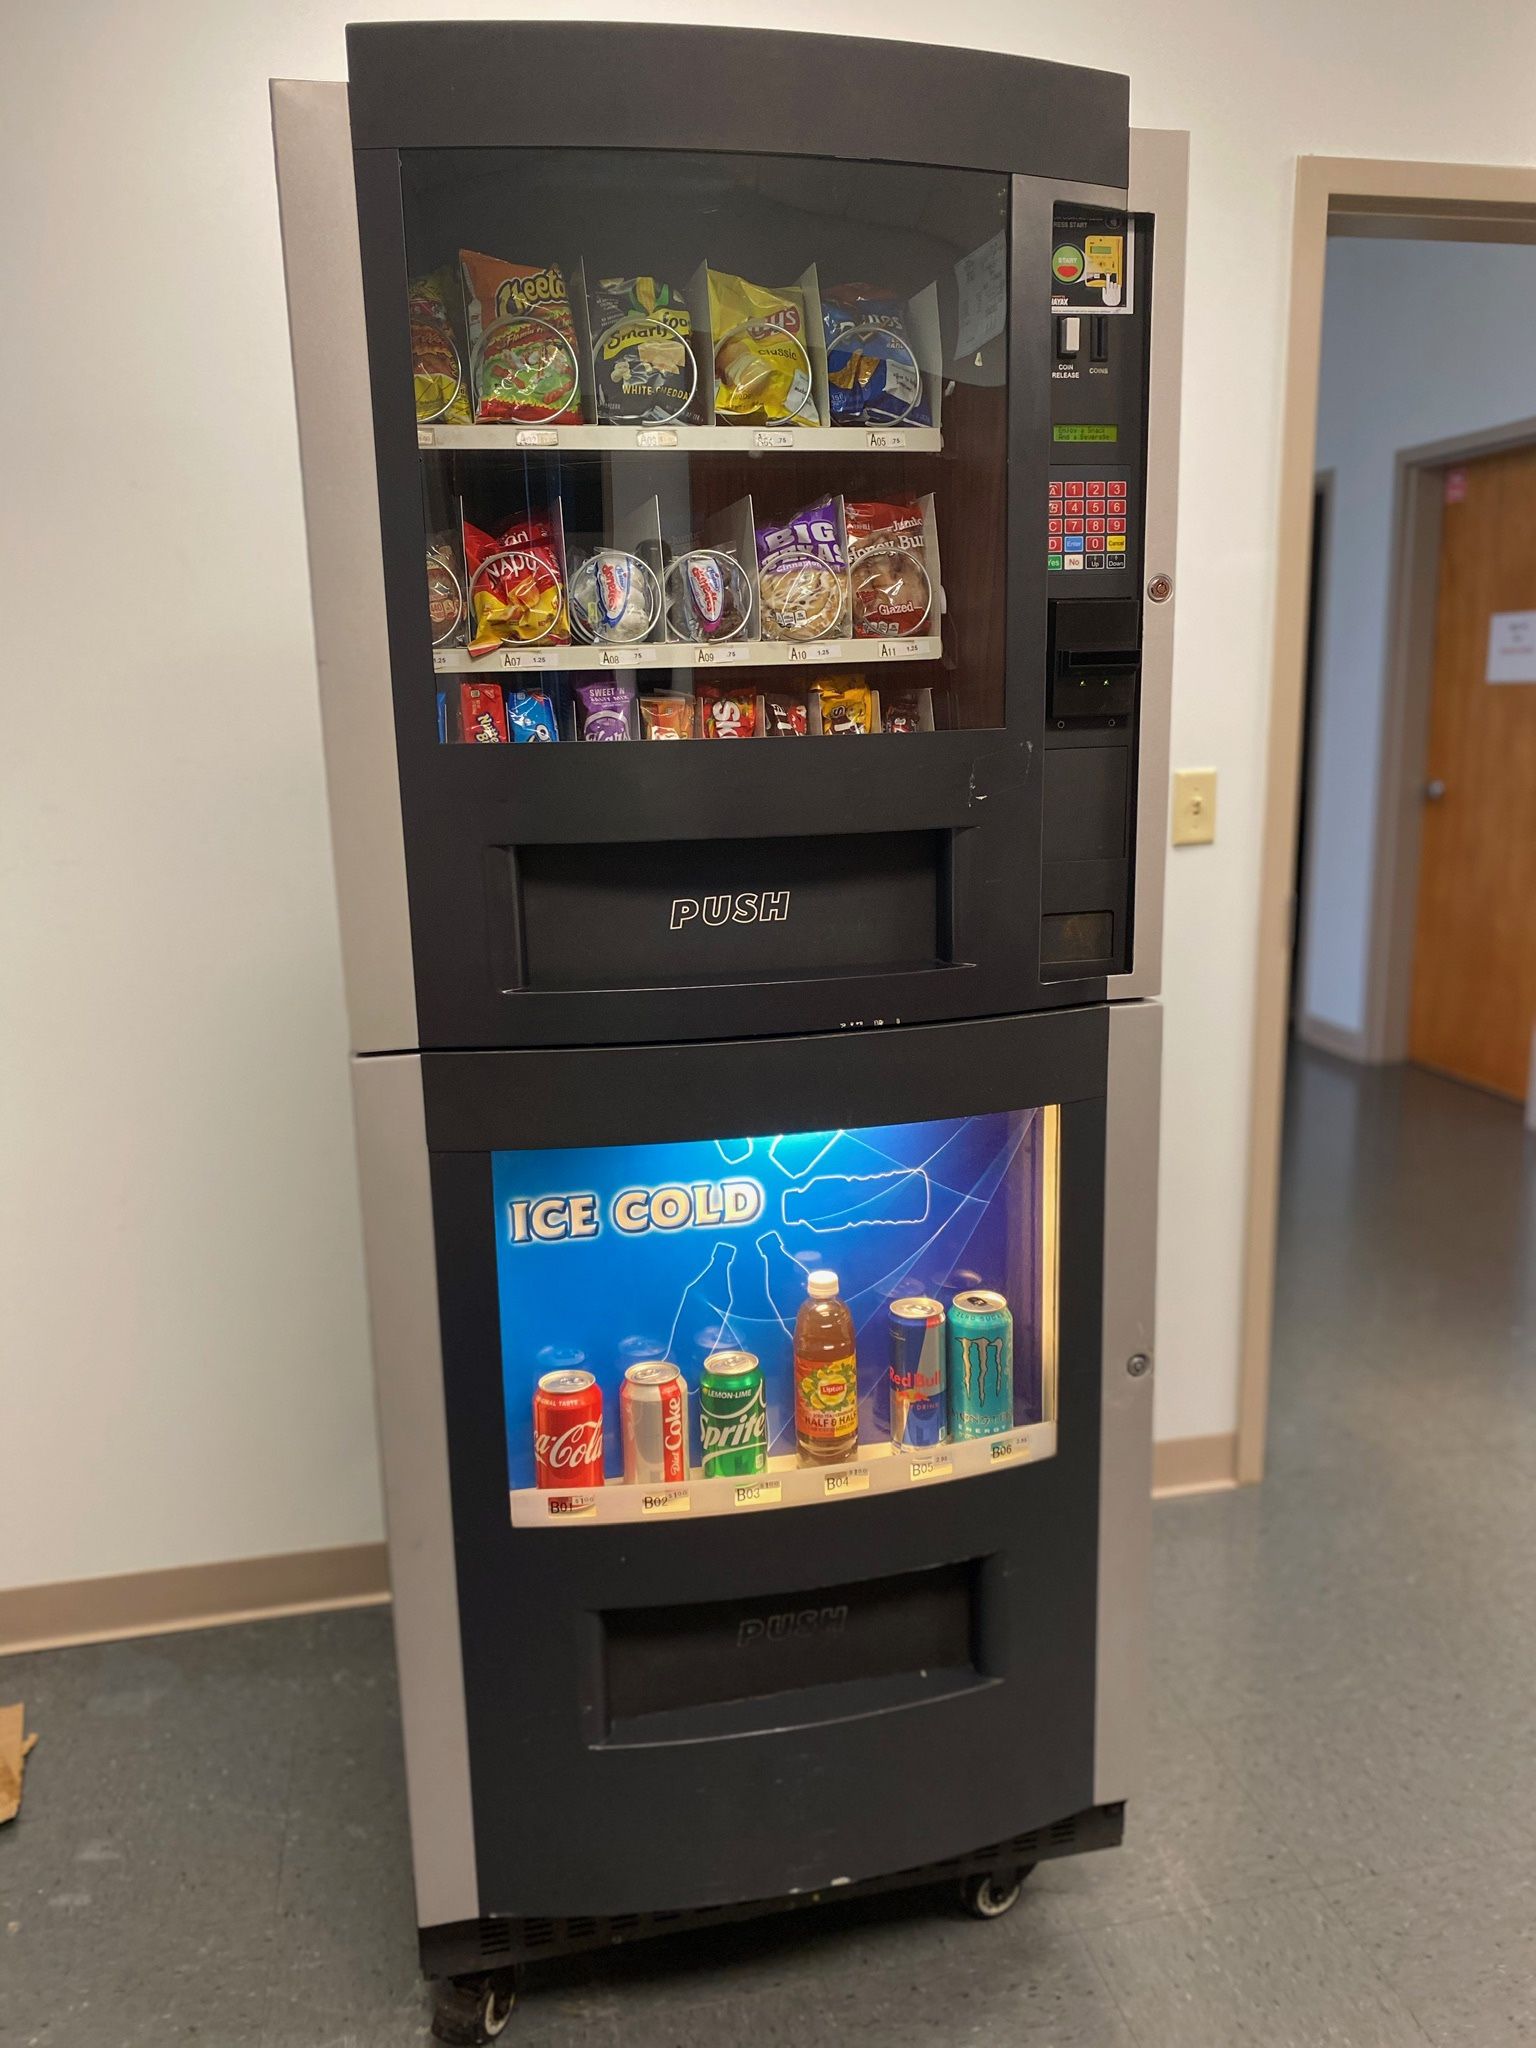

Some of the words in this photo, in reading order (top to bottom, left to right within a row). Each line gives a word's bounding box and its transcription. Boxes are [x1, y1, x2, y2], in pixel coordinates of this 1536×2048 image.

[1089, 367, 1109, 375] COINS
[622, 384, 653, 395] WHITE
[870, 433, 886, 447] A05
[1093, 485, 1099, 495] 2
[1114, 485, 1120, 495] 3
[1071, 503, 1078, 513] 4
[1092, 503, 1099, 513] 5
[1113, 503, 1120, 513] 6
[1049, 522, 1057, 532] C
[1071, 521, 1077, 531] 7
[1092, 521, 1099, 531] 8
[1113, 521, 1120, 531] 9
[764, 521, 836, 552] BIG
[1049, 539, 1057, 549] D
[1066, 540, 1082, 548] Enter
[1068, 558, 1080, 566] No
[1091, 560, 1100, 568] Up
[878, 601, 915, 616] Glazed
[698, 649, 715, 662] A09
[791, 647, 807, 660] A10
[881, 643, 896, 657] A11
[504, 653, 521, 667] A07
[603, 651, 620, 664] A08
[589, 687, 615, 697] SWEET
[669, 890, 791, 930] PUSH
[509, 1193, 601, 1245] ICE
[612, 1180, 763, 1234] COLD
[889, 1365, 912, 1388] Red
[915, 1369, 941, 1388] Bull
[708, 1388, 753, 1400] LEMON-LIME
[822, 1385, 844, 1394] Lipton
[664, 1395, 682, 1451] Coke
[805, 1415, 829, 1427] HALF
[699, 1411, 766, 1450] Sprite
[992, 1445, 1012, 1459] B06
[670, 1451, 681, 1476] Diet
[912, 1462, 934, 1477] B05
[826, 1477, 849, 1491] B04
[736, 1487, 761, 1501] B03
[550, 1500, 574, 1514] B01
[644, 1496, 668, 1509] B02
